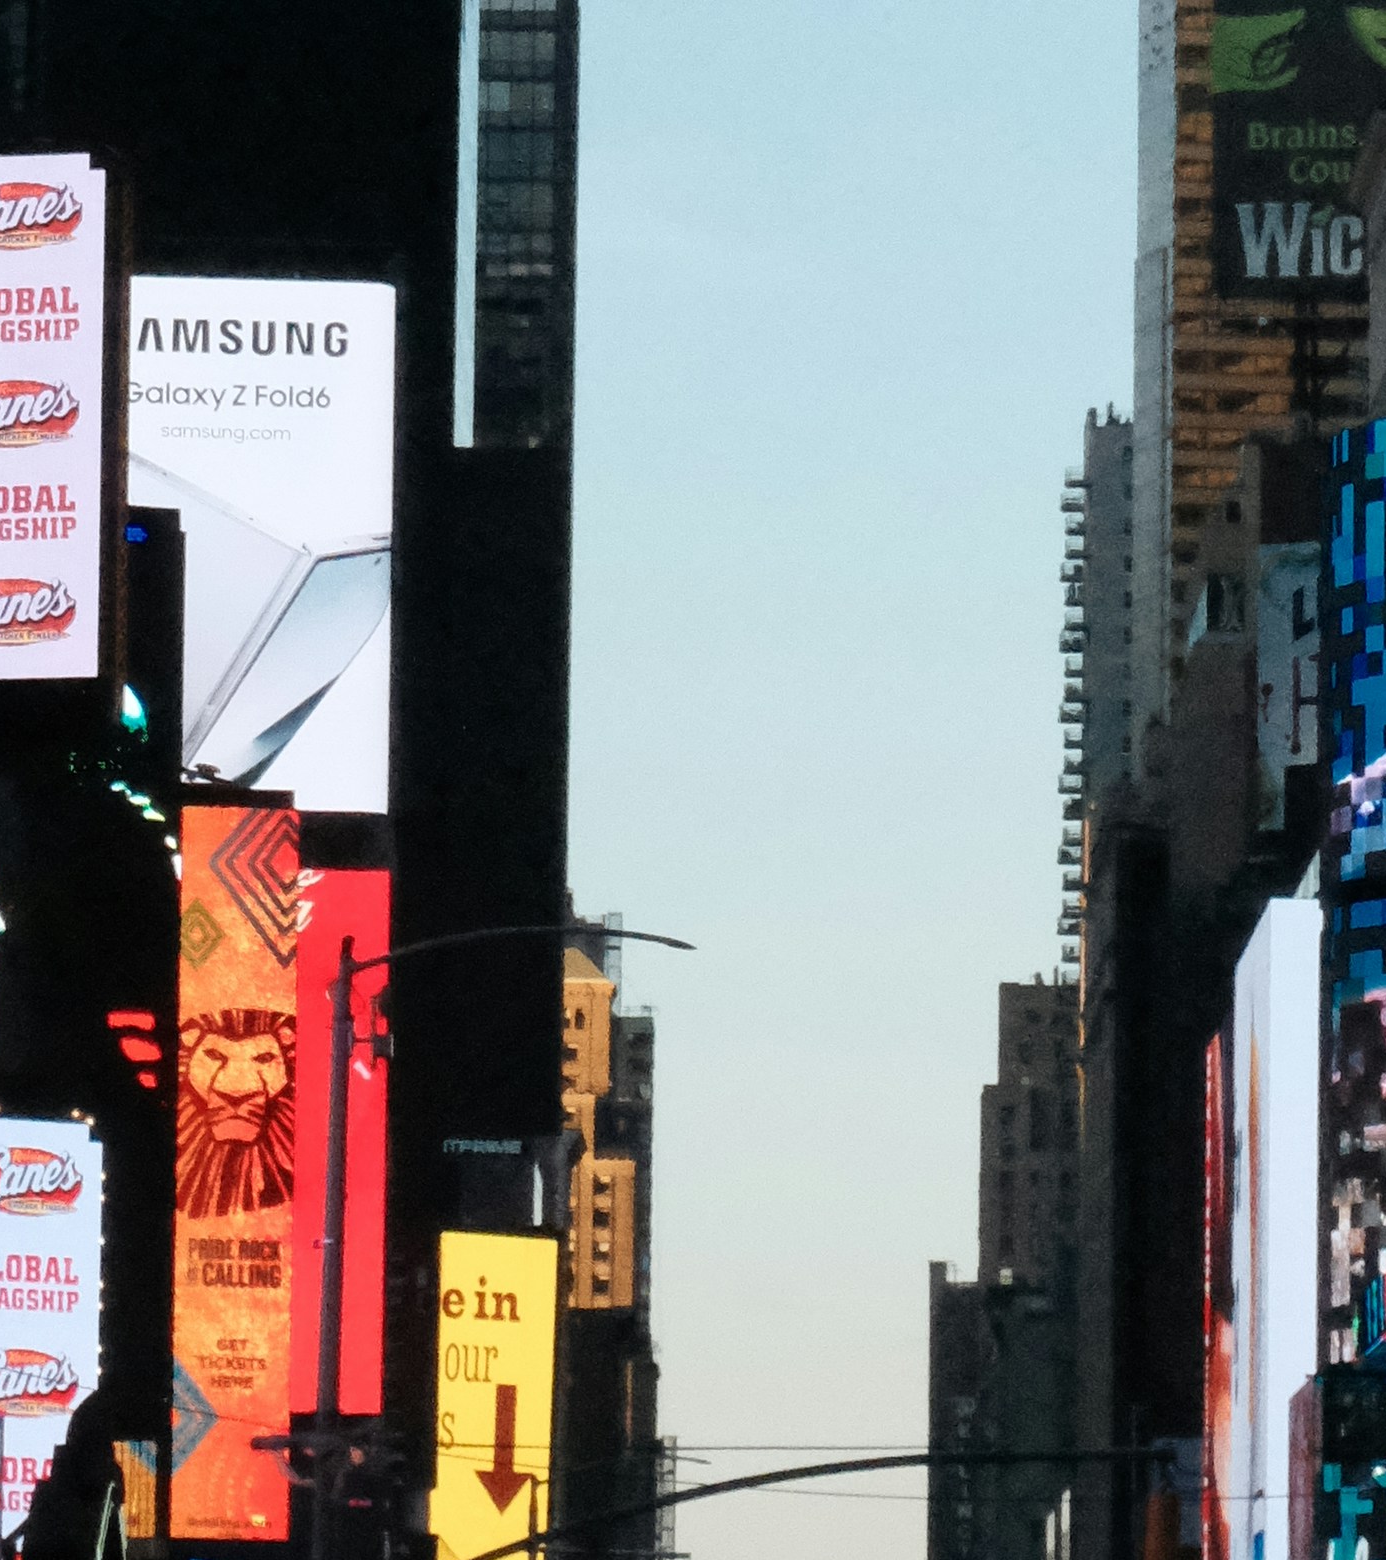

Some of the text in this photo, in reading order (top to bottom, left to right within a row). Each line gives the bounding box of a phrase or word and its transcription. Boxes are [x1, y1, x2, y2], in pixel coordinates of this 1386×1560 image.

[137, 317, 349, 358] AMSUNG
[232, 384, 248, 407] Z
[254, 384, 332, 408] Fold6
[160, 424, 292, 444] samsung.com
[202, 1262, 282, 1288] CALLING
[474, 1275, 521, 1323] in
[198, 1355, 267, 1371] TICKETS
